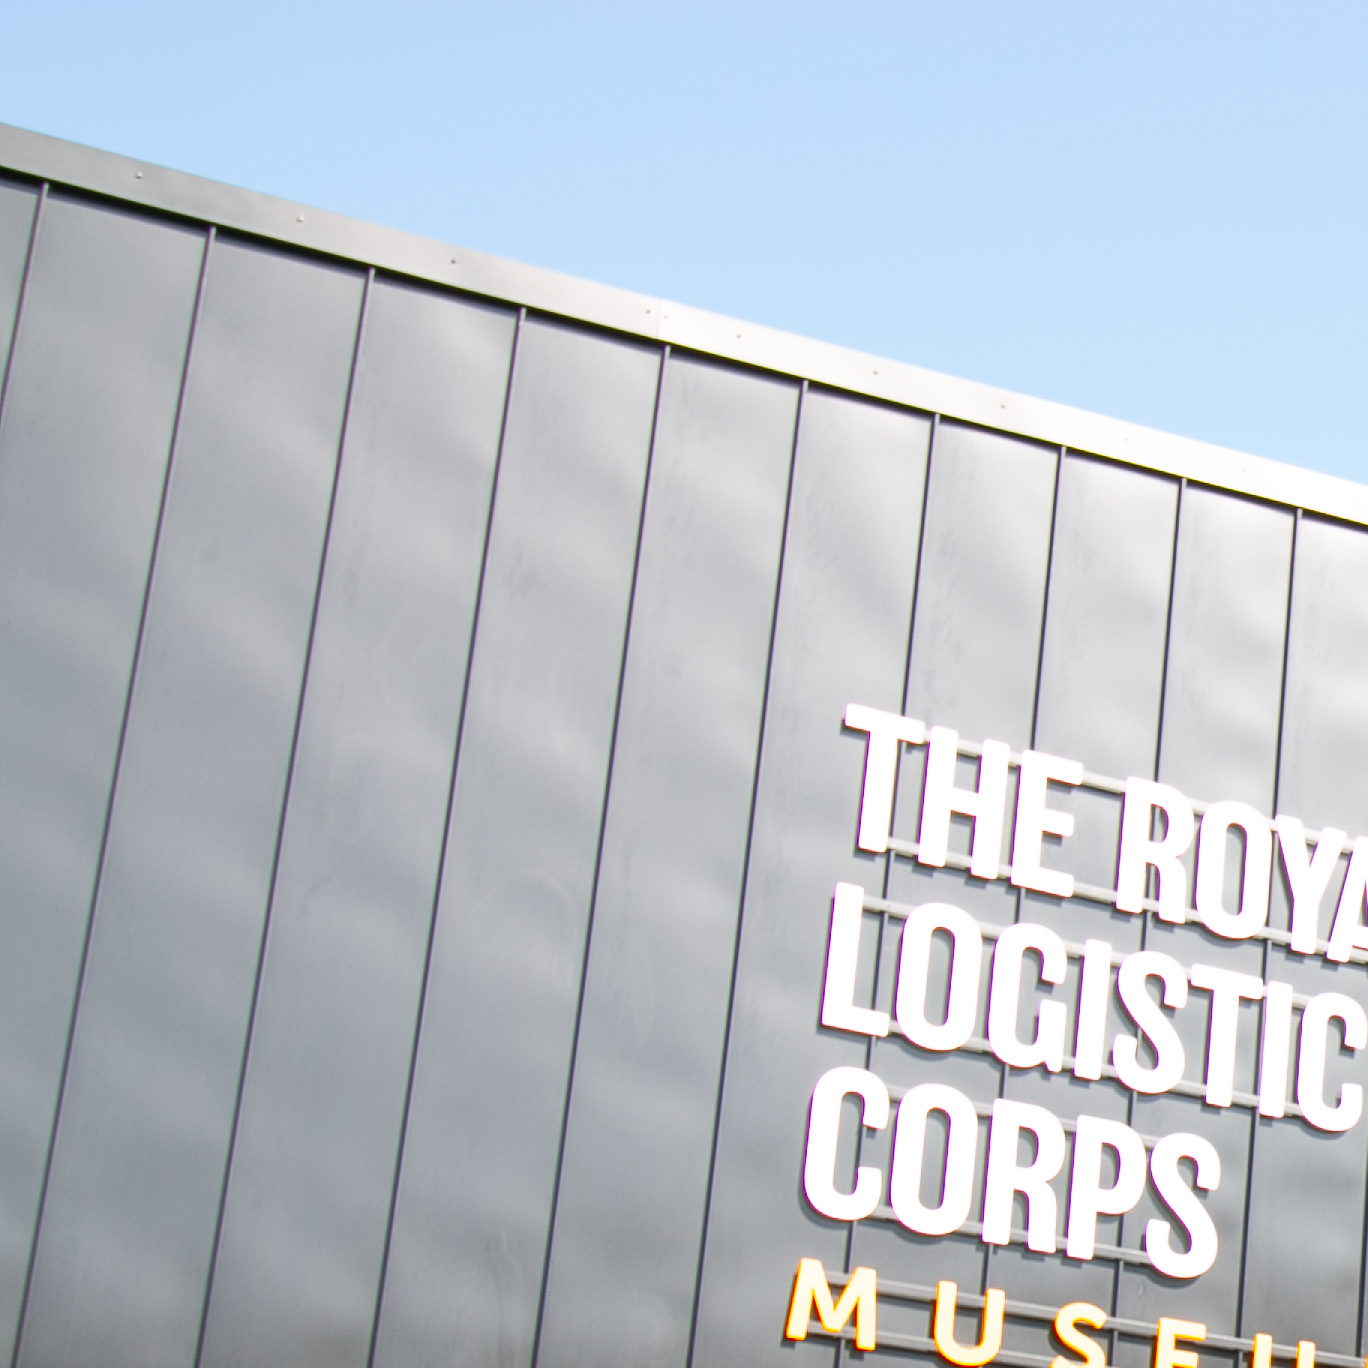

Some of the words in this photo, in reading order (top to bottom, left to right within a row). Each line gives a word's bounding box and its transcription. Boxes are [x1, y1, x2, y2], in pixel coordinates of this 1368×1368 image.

[845, 703, 1084, 898] THE
[821, 882, 1368, 1132] LOGISTIC
[803, 1066, 1222, 1279] CORPS
